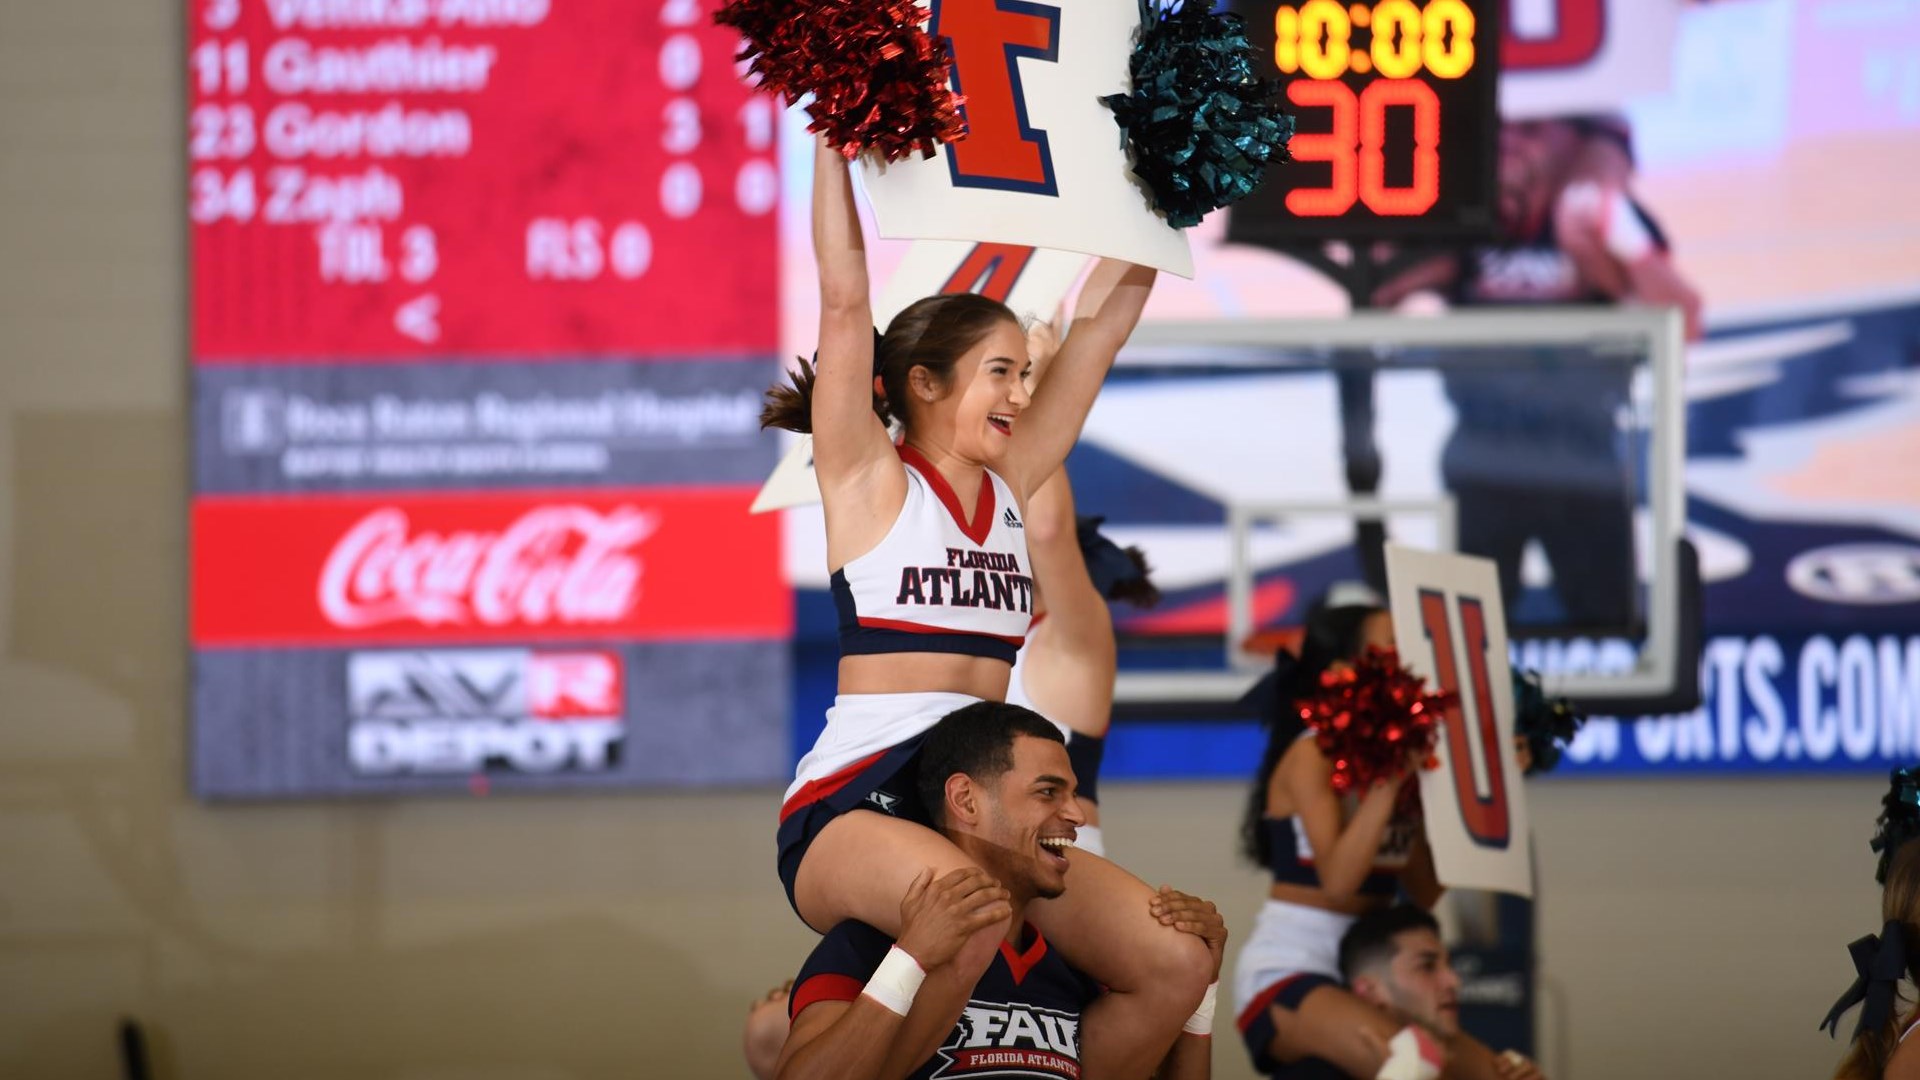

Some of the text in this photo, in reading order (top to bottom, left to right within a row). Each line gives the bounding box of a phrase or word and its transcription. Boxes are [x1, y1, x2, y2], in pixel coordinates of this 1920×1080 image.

[192, 38, 250, 94] 11
[263, 37, 497, 93] Gauthier
[659, 34, 701, 90] 0
[1275, 0, 1475, 79] 10:00
[191, 97, 773, 159] 23 Gordon 3 1
[1285, 79, 1440, 216] 30
[191, 168, 256, 224] 34
[660, 161, 702, 218] 0
[735, 158, 777, 216] 0
[400, 225, 438, 283] 3
[610, 221, 652, 278] 0
[946, 547, 1020, 573] FLORIDA
[349, 721, 622, 772] DEPOT
[1418, 588, 1511, 850] U
[962, 1007, 1079, 1060] FAU
[970, 1052, 1078, 1077] FLORIDA ATLANTIC
